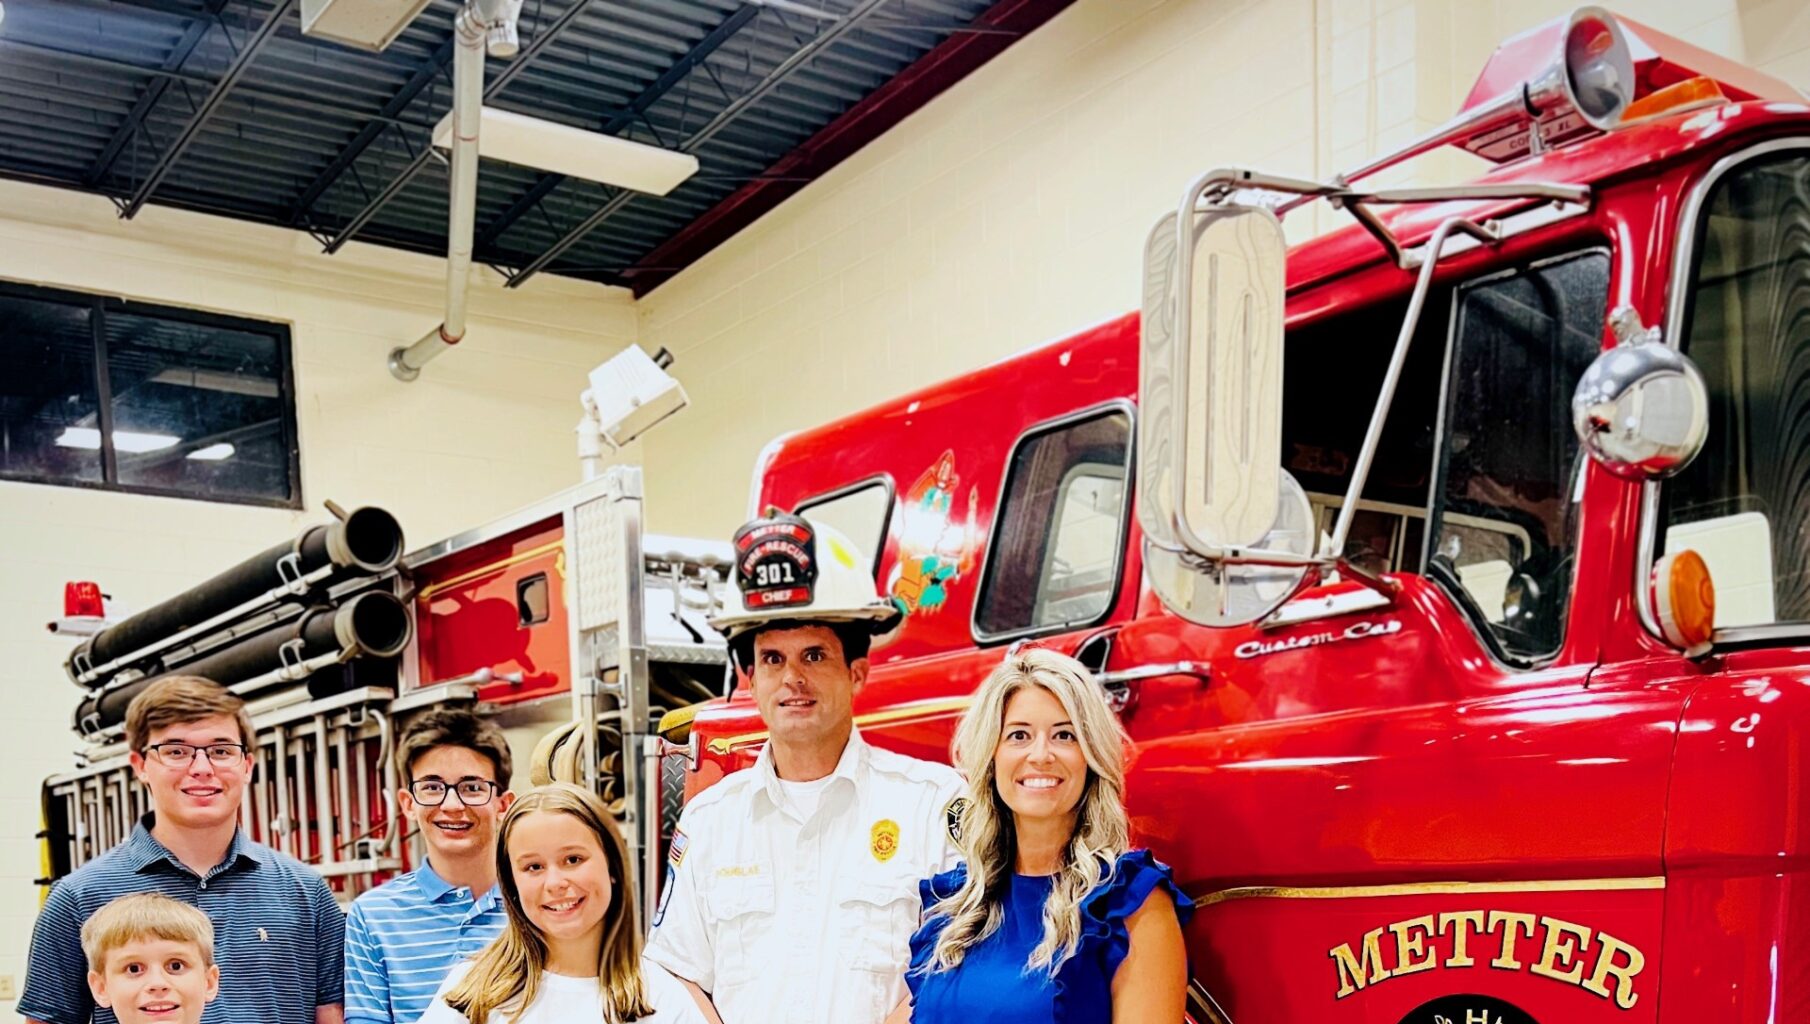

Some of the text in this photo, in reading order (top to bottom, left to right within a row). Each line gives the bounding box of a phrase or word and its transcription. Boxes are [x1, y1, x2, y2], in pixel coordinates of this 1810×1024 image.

[751, 524, 795, 539] METTER
[756, 562, 795, 586] 301
[761, 589, 793, 604] CHIEF
[1234, 620, 1402, 658] Custom Cab
[1330, 910, 1645, 1009] METTER
